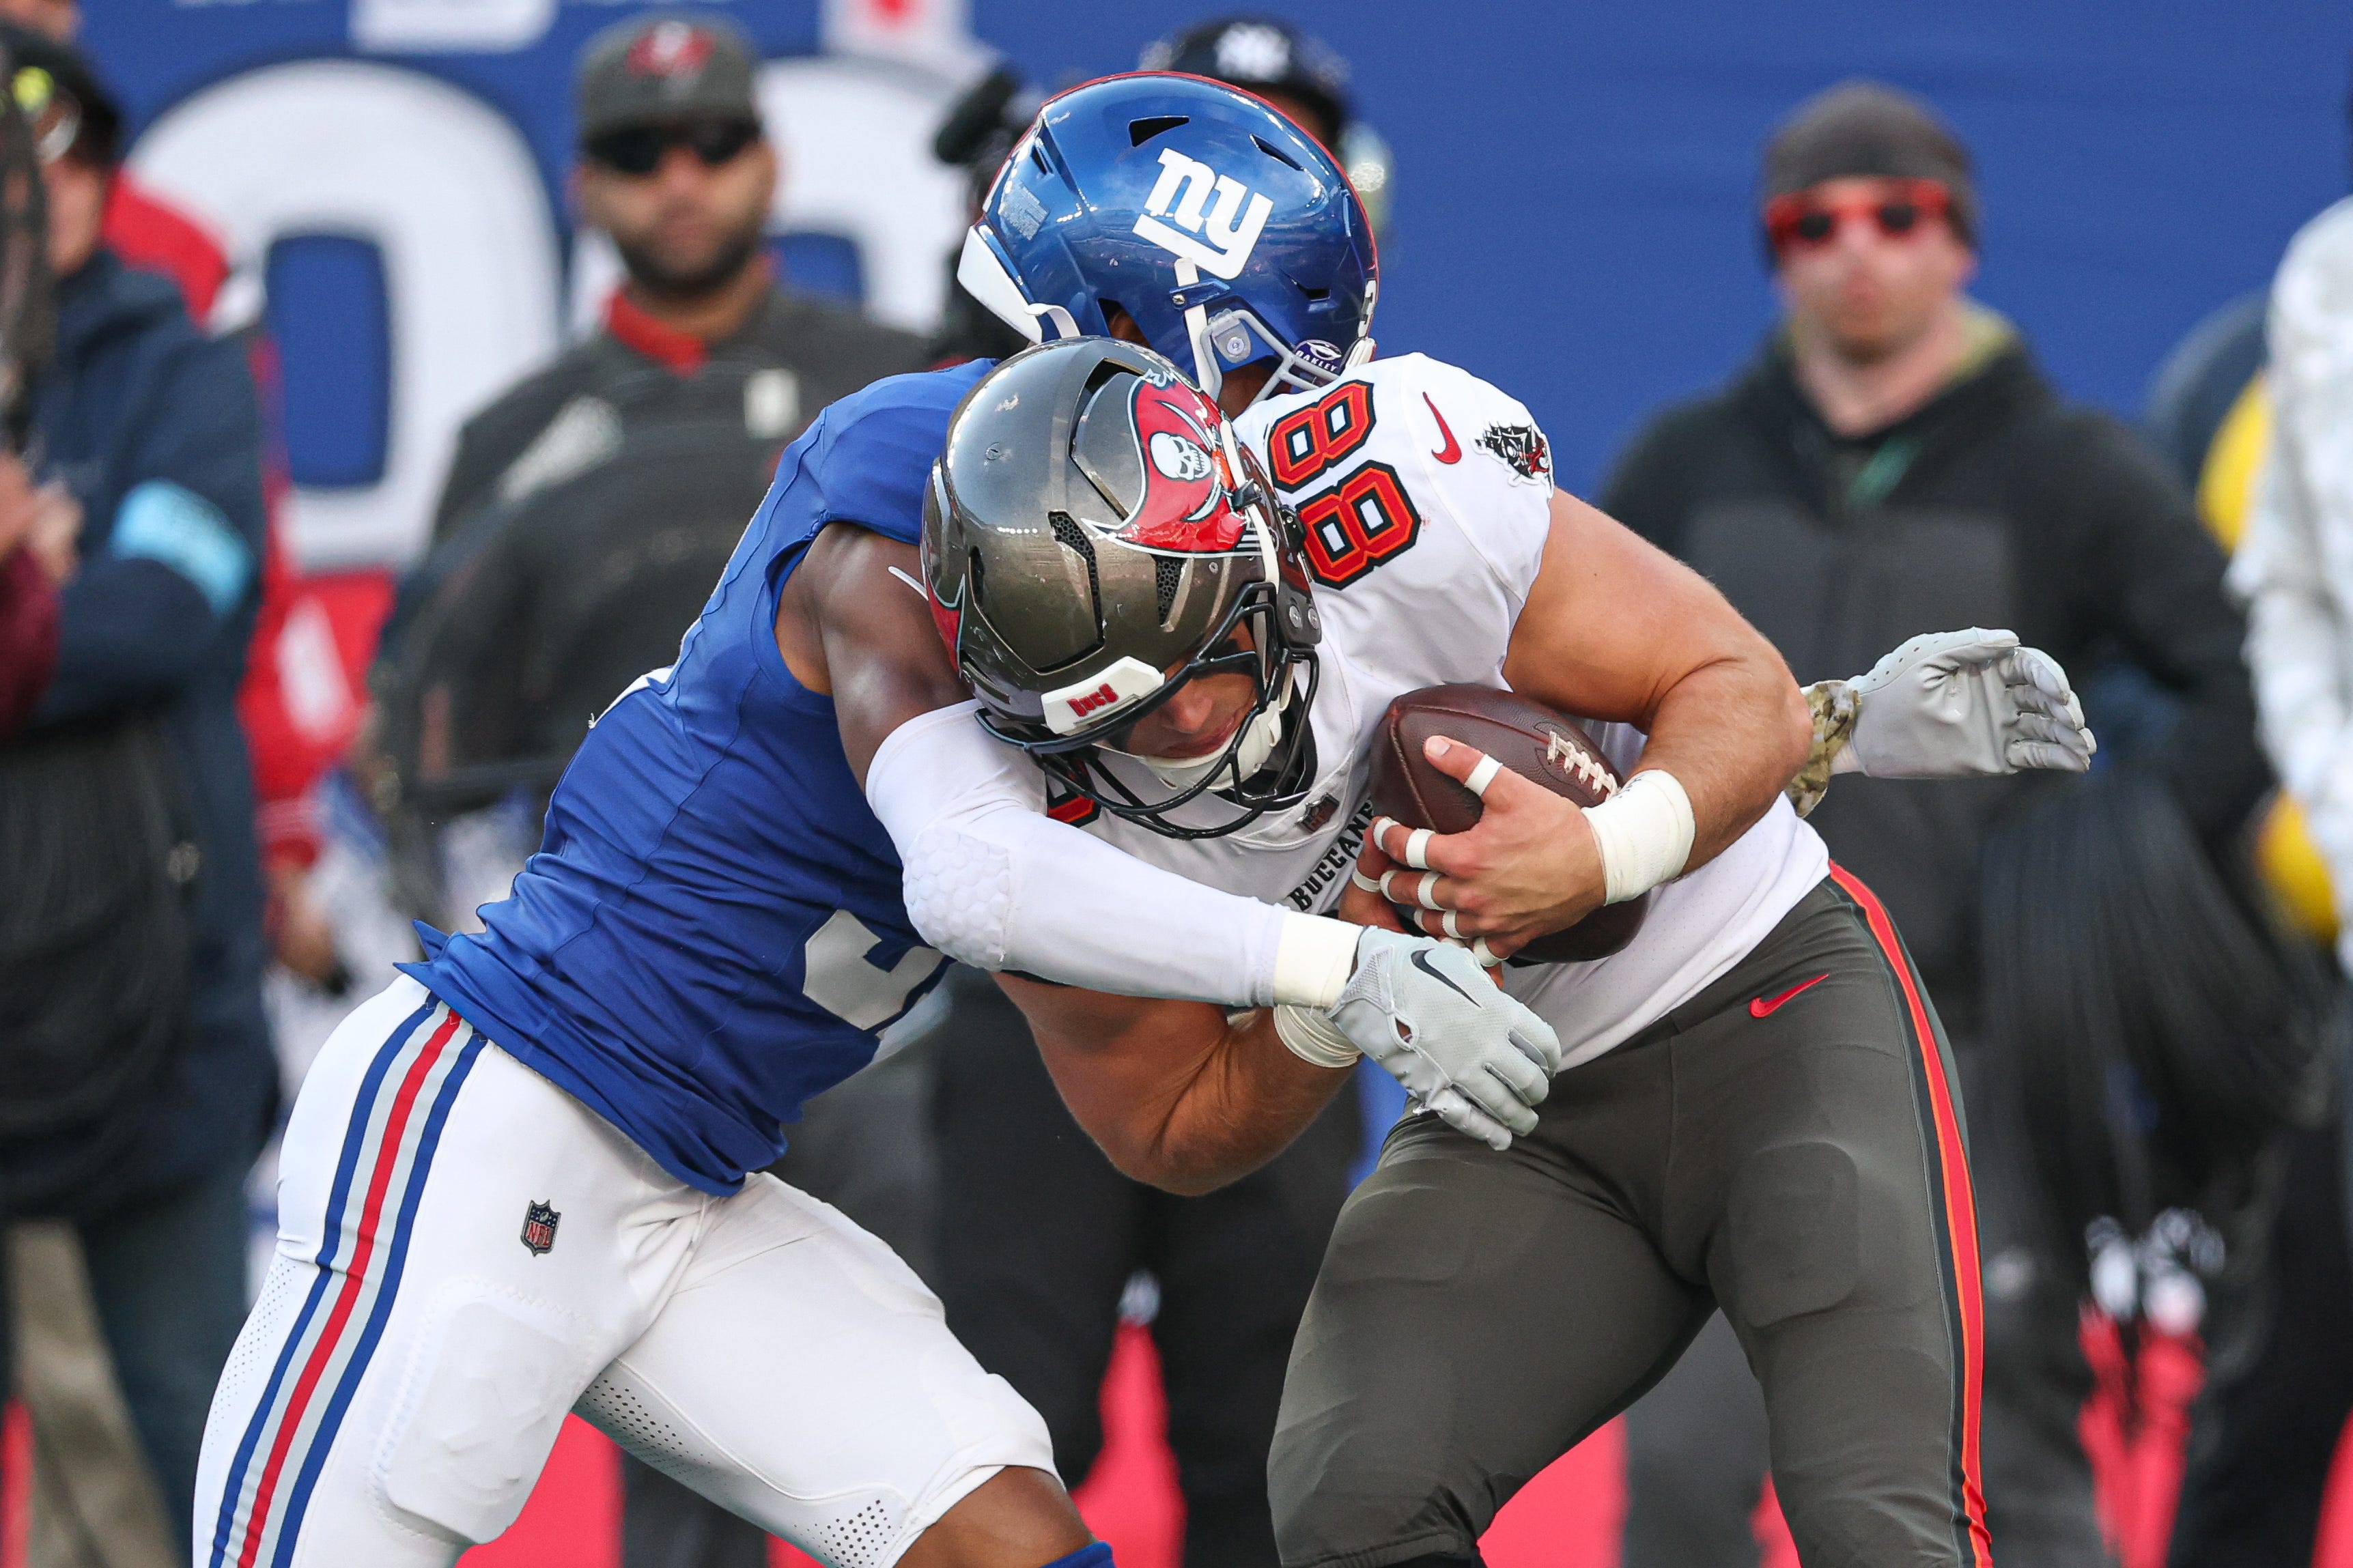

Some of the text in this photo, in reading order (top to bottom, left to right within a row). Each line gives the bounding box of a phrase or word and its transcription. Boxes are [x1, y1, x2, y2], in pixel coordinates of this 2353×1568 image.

[1295, 350, 1338, 371] OAKLEY
[1269, 380, 1421, 589] 88
[525, 1221, 550, 1246] NFL
